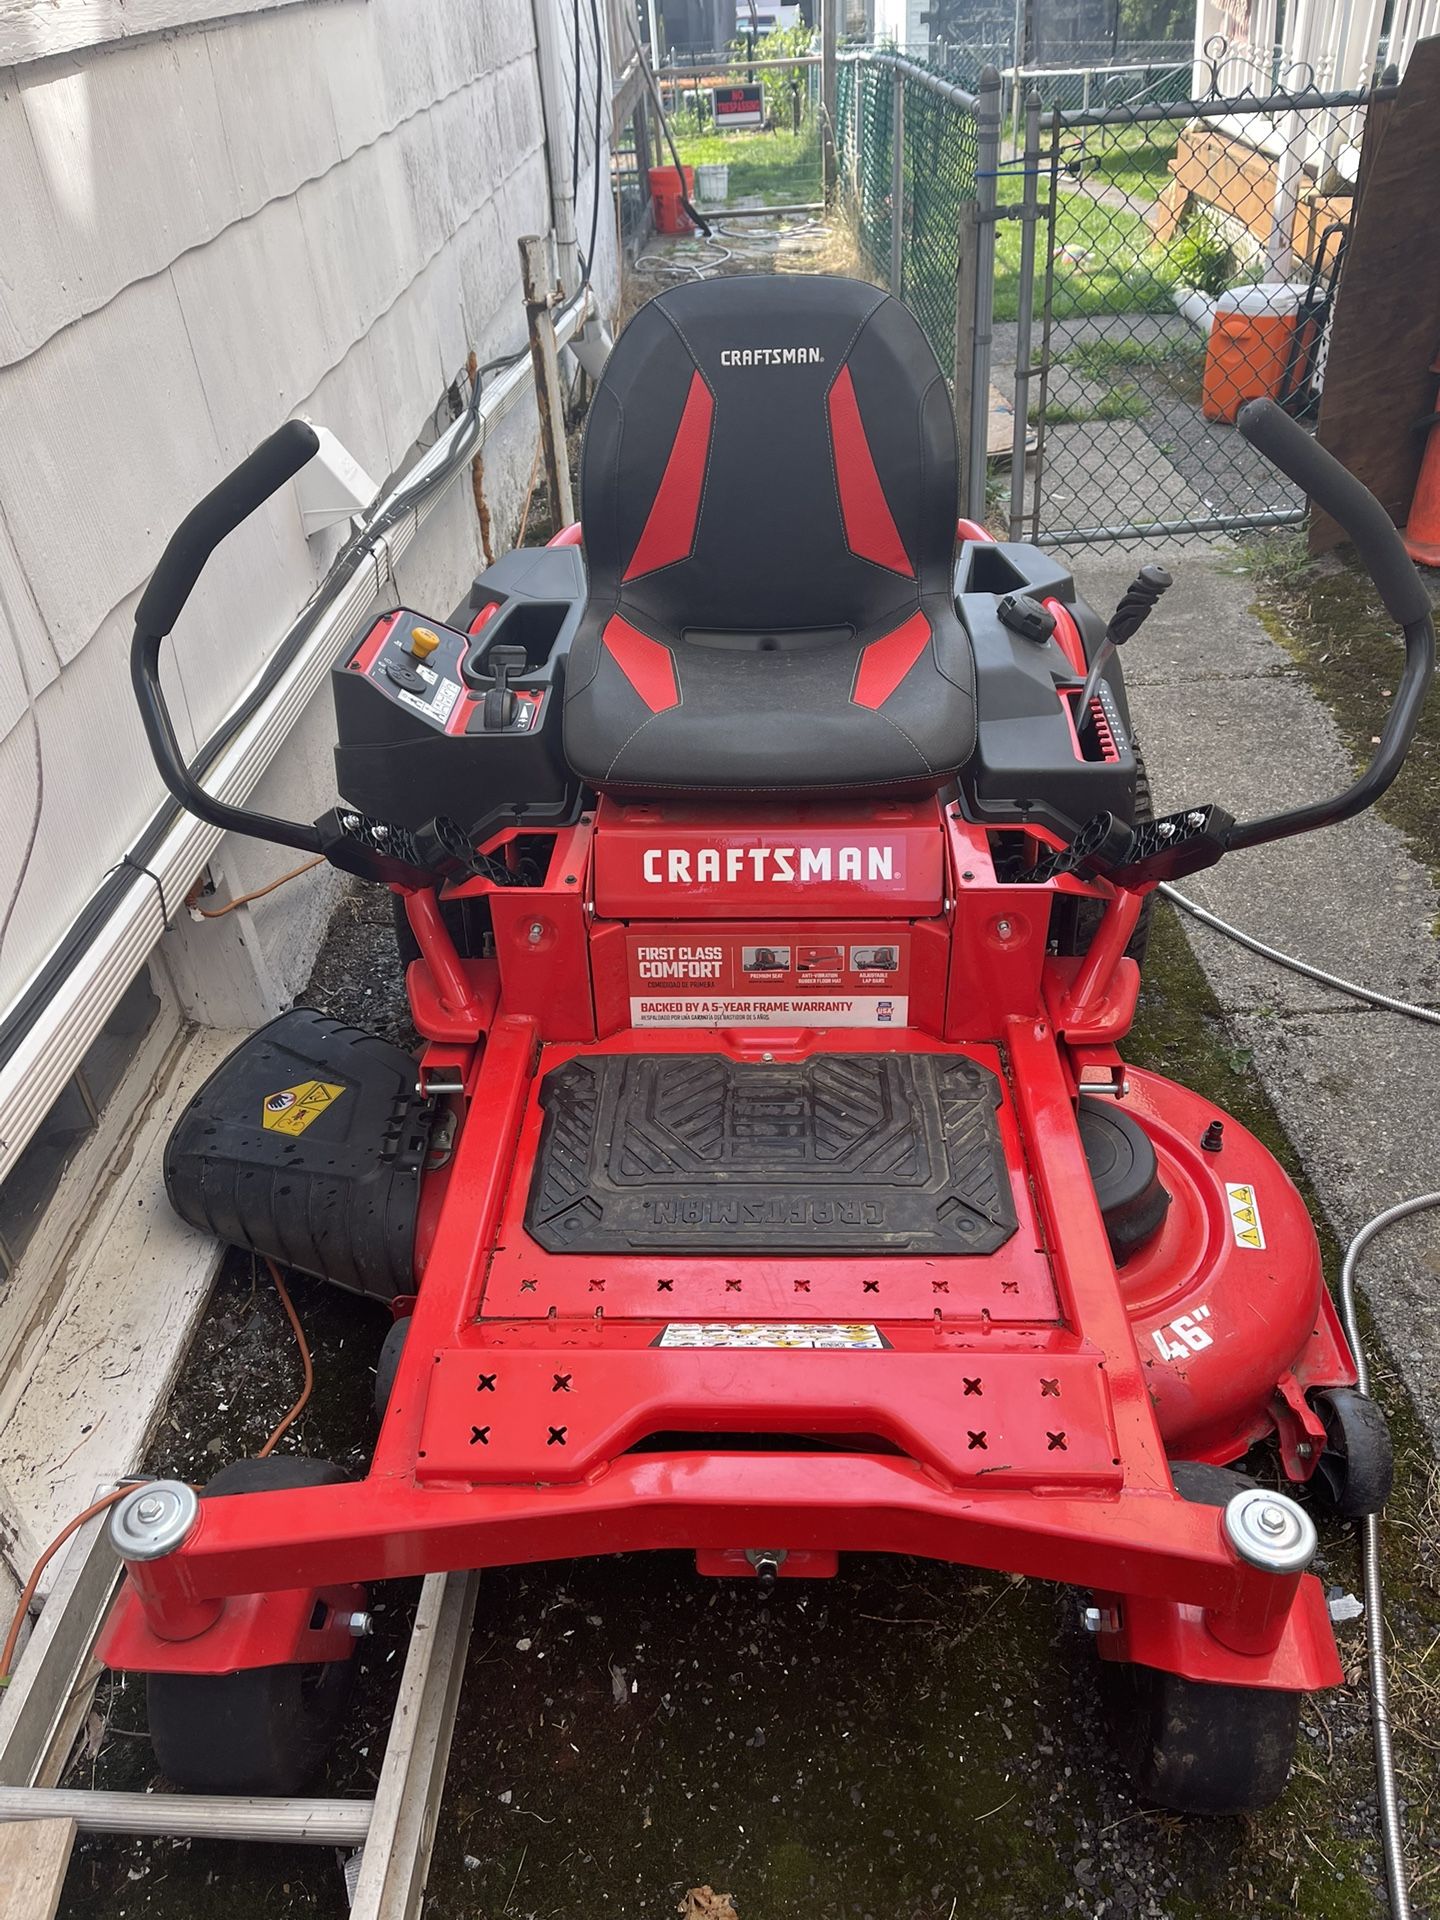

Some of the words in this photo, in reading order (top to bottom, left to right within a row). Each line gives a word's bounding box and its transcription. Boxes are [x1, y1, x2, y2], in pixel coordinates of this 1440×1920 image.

[731, 89, 744, 101] NO
[720, 347, 820, 366] CRAFTSMAN
[643, 846, 893, 883] CRAFTSMAN
[637, 947, 676, 960] FIRST
[678, 947, 723, 960] CLASS
[639, 961, 723, 978] COMFORT
[640, 1002, 683, 1012] BACKED
[685, 1002, 699, 1012] BY
[701, 1002, 710, 1012] A
[711, 1002, 751, 1012] 5-YEAR
[753, 1002, 789, 1012] FRAME
[791, 1001, 853, 1012] WARRANTY
[653, 1200, 884, 1225] CRAFTSMAN
